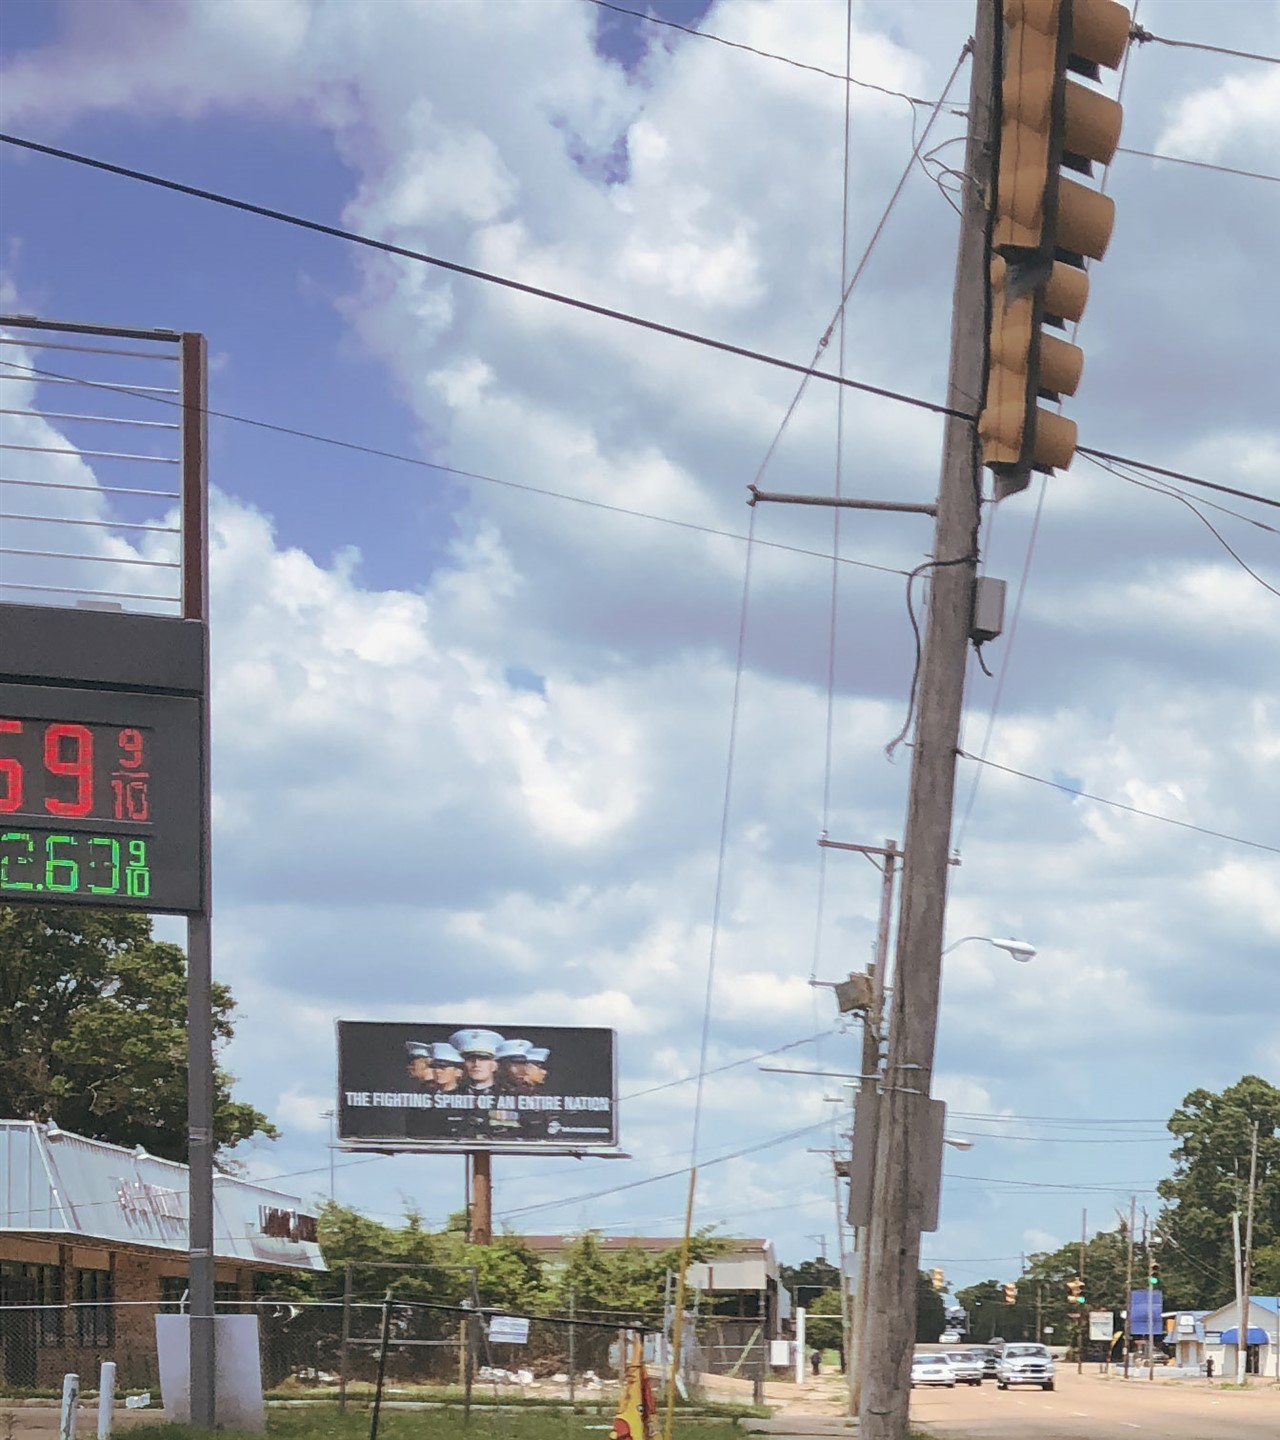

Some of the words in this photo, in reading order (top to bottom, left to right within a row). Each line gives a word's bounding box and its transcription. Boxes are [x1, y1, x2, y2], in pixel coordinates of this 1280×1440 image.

[345, 1091, 372, 1106] THE
[373, 1092, 432, 1108] FIGHTING
[434, 1093, 475, 1109] SPIRIT
[477, 1095, 495, 1109] OF
[497, 1095, 516, 1109] AN
[518, 1095, 562, 1110] ENTIRE
[564, 1096, 609, 1111] NATION
